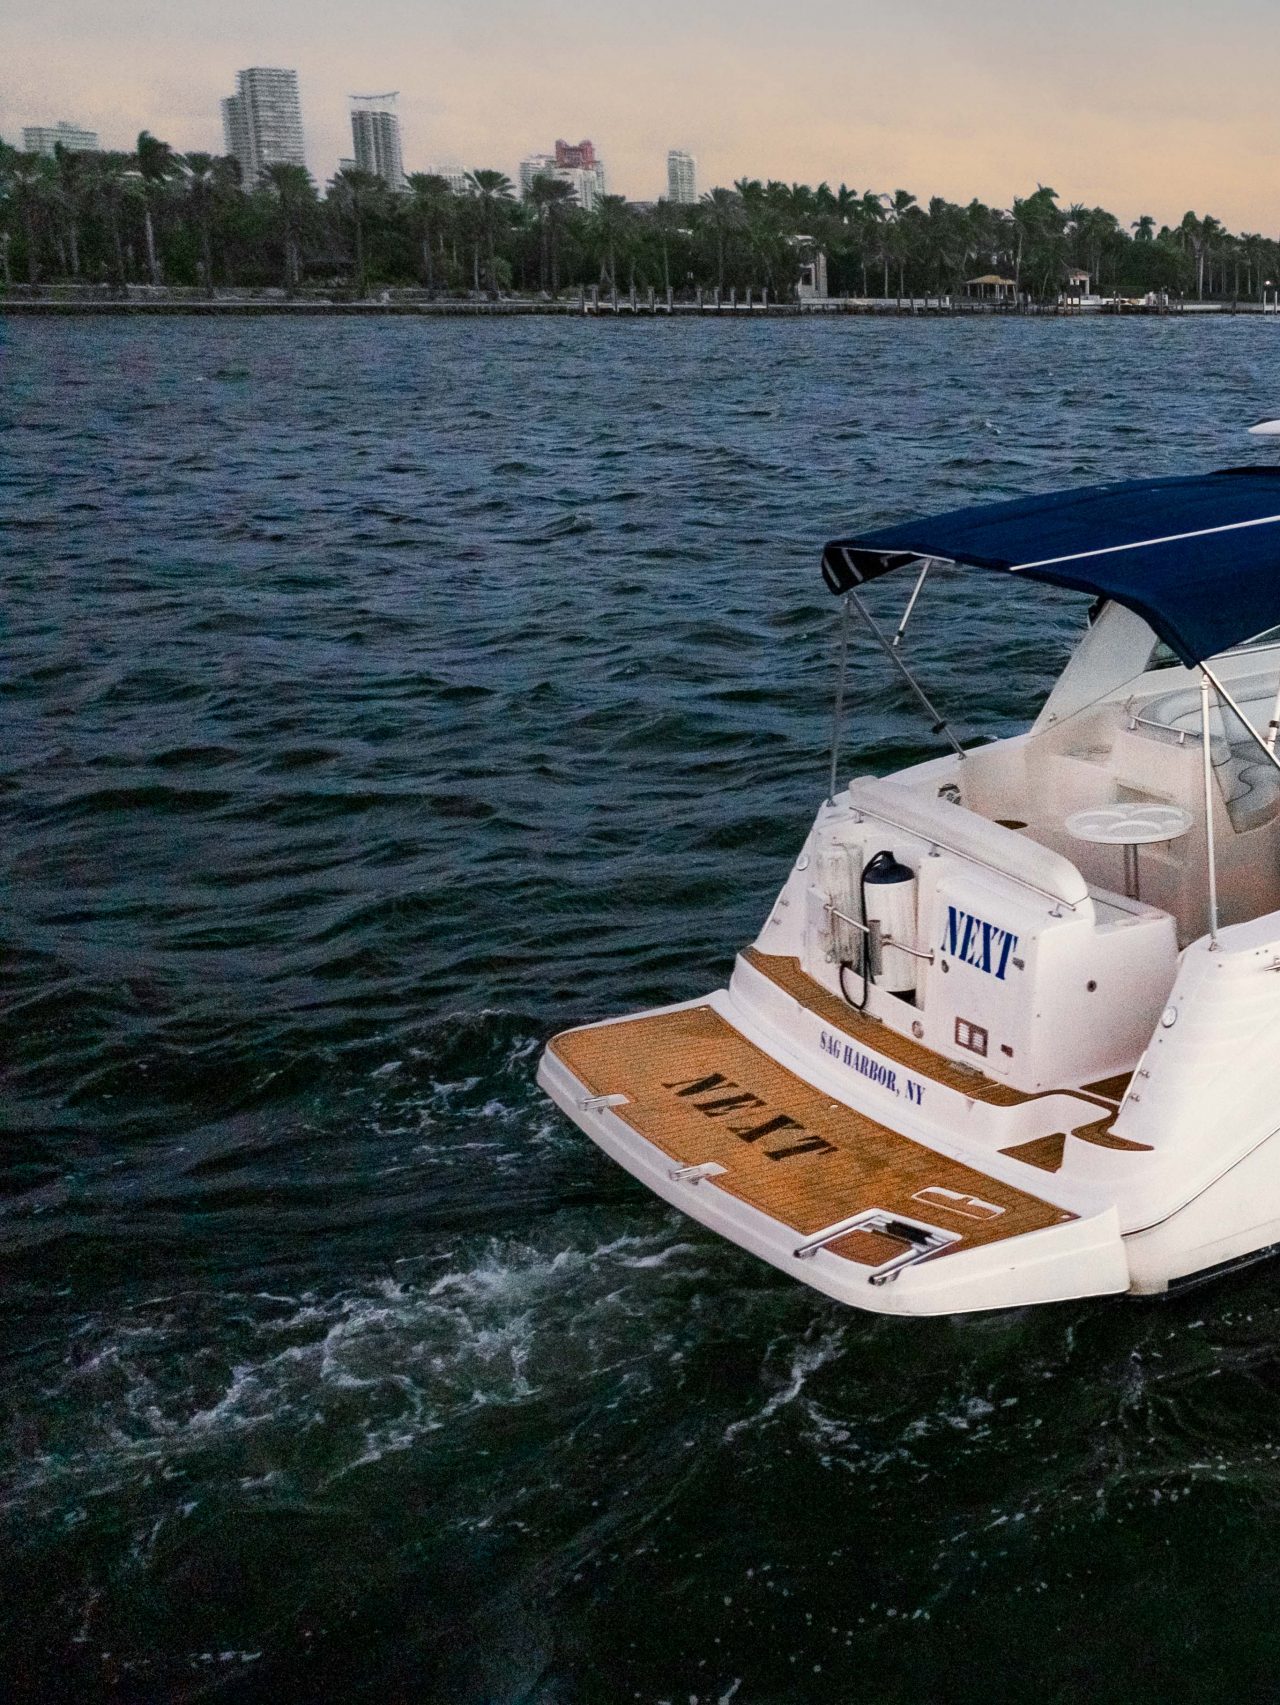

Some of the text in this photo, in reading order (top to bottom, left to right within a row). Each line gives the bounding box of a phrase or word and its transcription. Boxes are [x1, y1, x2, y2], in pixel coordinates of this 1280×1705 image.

[940, 905, 1020, 981] NEXT
[819, 1030, 926, 1106] SAG HARBOR, NY
[661, 1072, 838, 1161] NEXT
